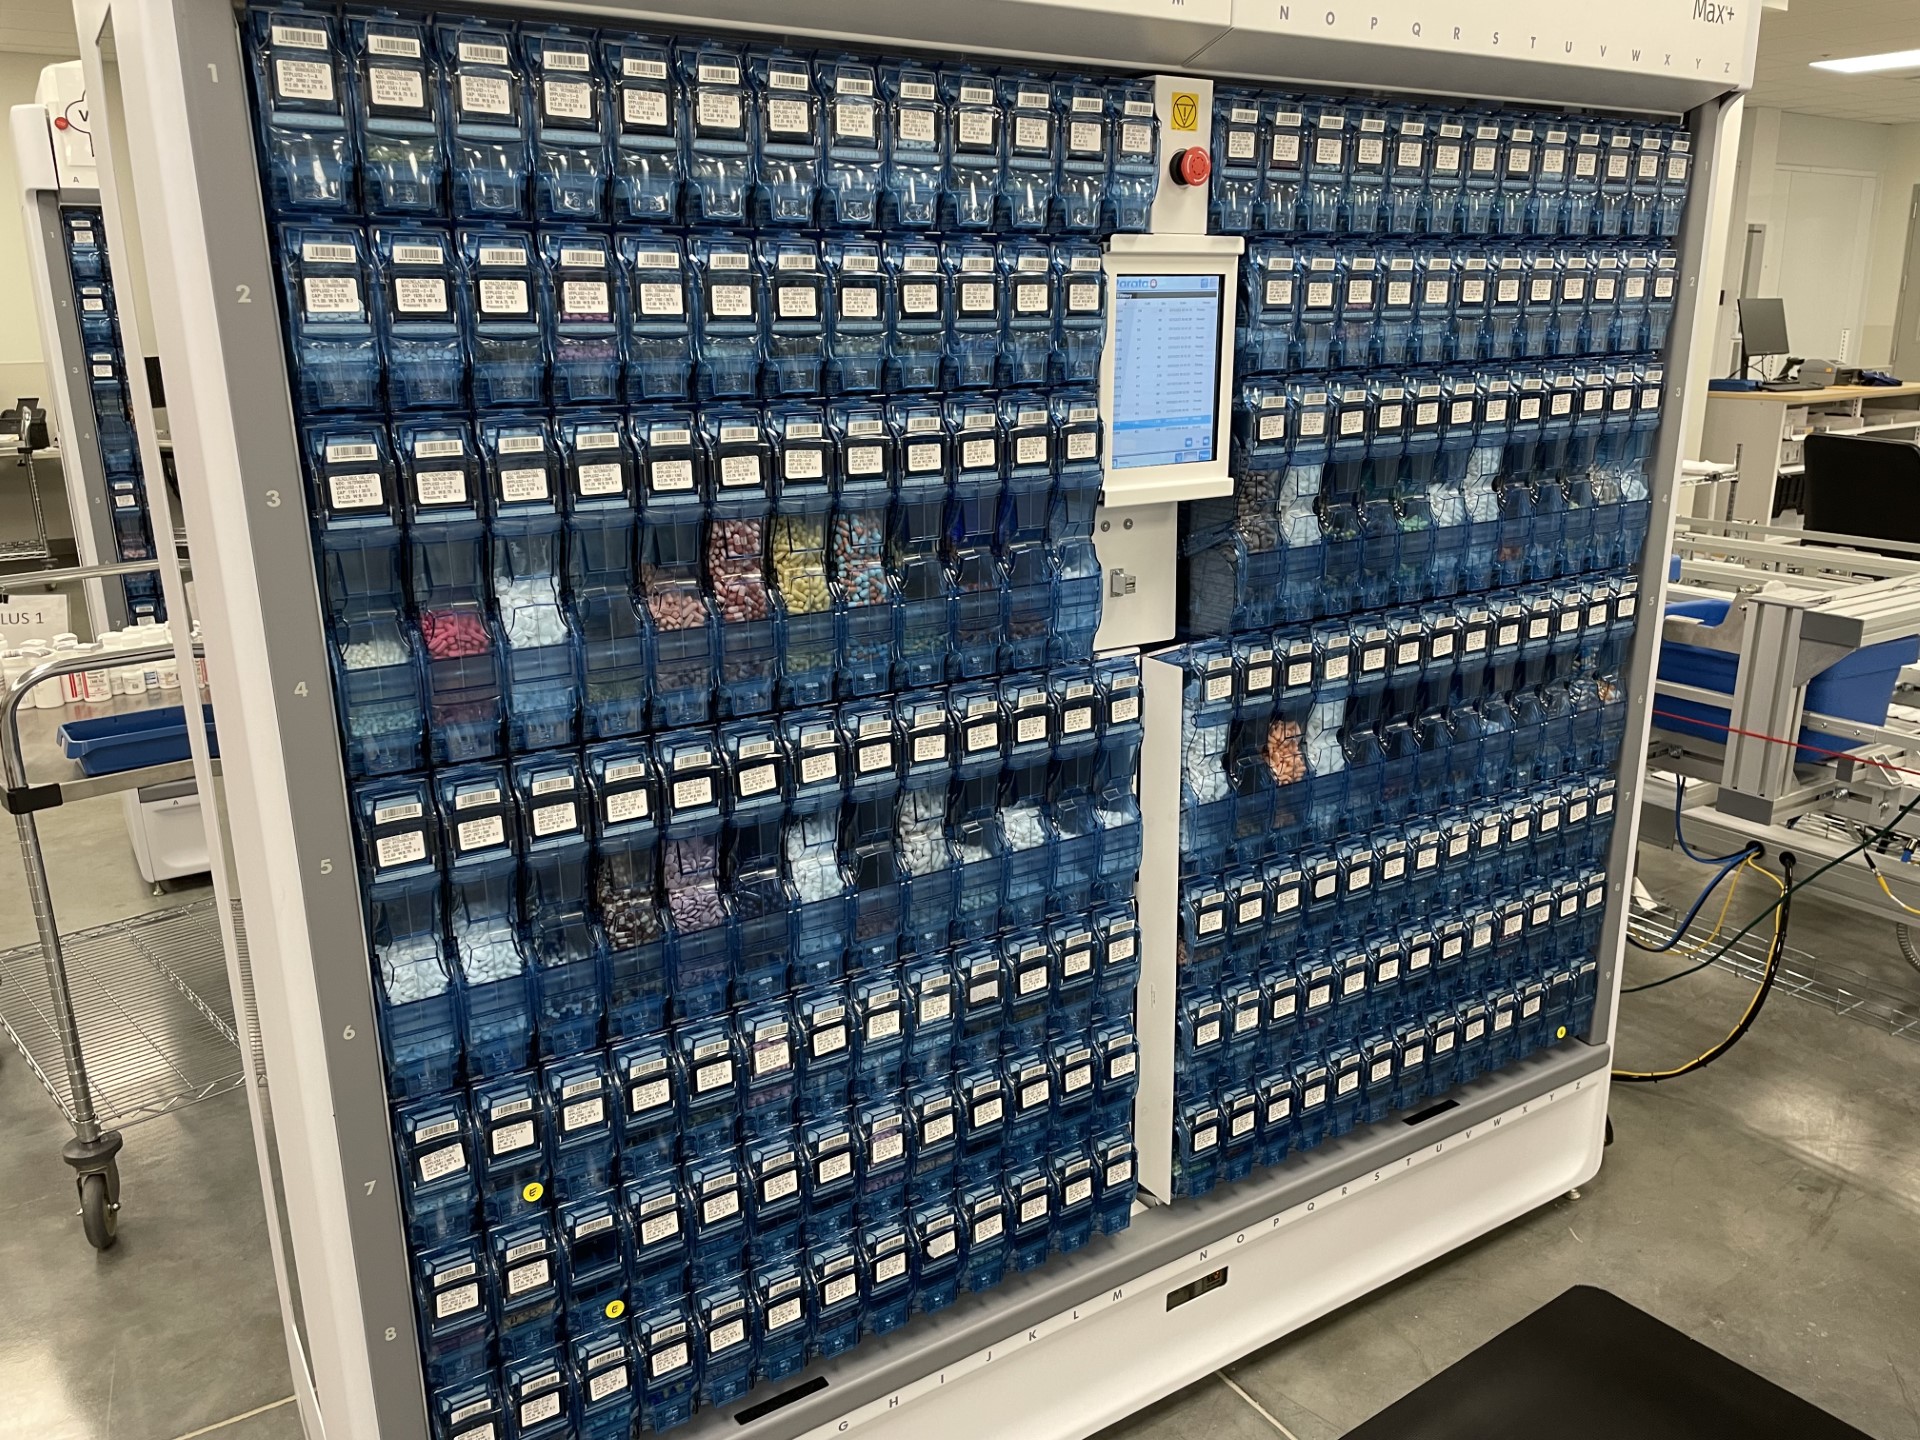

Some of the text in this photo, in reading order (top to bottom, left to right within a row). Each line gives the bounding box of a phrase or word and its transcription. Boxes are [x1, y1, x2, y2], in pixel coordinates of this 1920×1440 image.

[1280, 6, 1730, 74] N O P Q R S T U V W X Y Z
[208, 64, 218, 82] 1
[1704, 162, 1708, 170] 1
[1690, 276, 1694, 286] 2
[236, 284, 252, 302] 2
[1676, 386, 1680, 398] 3
[266, 490, 280, 508] 3
[1662, 494, 1668, 502] 4
[1649, 596, 1654, 606] 5
[1, 612, 44, 624] LUS 1
[294, 682, 308, 696] 4
[1638, 694, 1642, 704] 6
[1626, 792, 1630, 800] 7
[320, 858, 332, 874] 5
[1614, 882, 1620, 892] 8
[1606, 972, 1610, 980] 9
[344, 1024, 356, 1040] 6
[364, 1180, 376, 1196] 7
[838, 1421, 848, 1431] G
[889, 1396, 898, 1408] H
[940, 1374, 944, 1384] I
[986, 1351, 992, 1362] J
[1029, 1330, 1036, 1341] K
[1074, 1311, 1079, 1320] L
[1112, 1290, 1122, 1301] M
[1200, 1250, 1208, 1261] N
[1236, 1234, 1244, 1244] O
[1273, 1218, 1279, 1227] P
[1307, 1202, 1314, 1211] Q
[1342, 1186, 1347, 1196] R
[1374, 1172, 1380, 1181] S
[1406, 1158, 1412, 1166] T
[1436, 1144, 1442, 1152] U
[1466, 1130, 1472, 1139] V
[1494, 1118, 1502, 1127] W
[1550, 1093, 1554, 1101] Y
[1576, 1082, 1580, 1090] Z
[384, 1326, 396, 1342] 8
